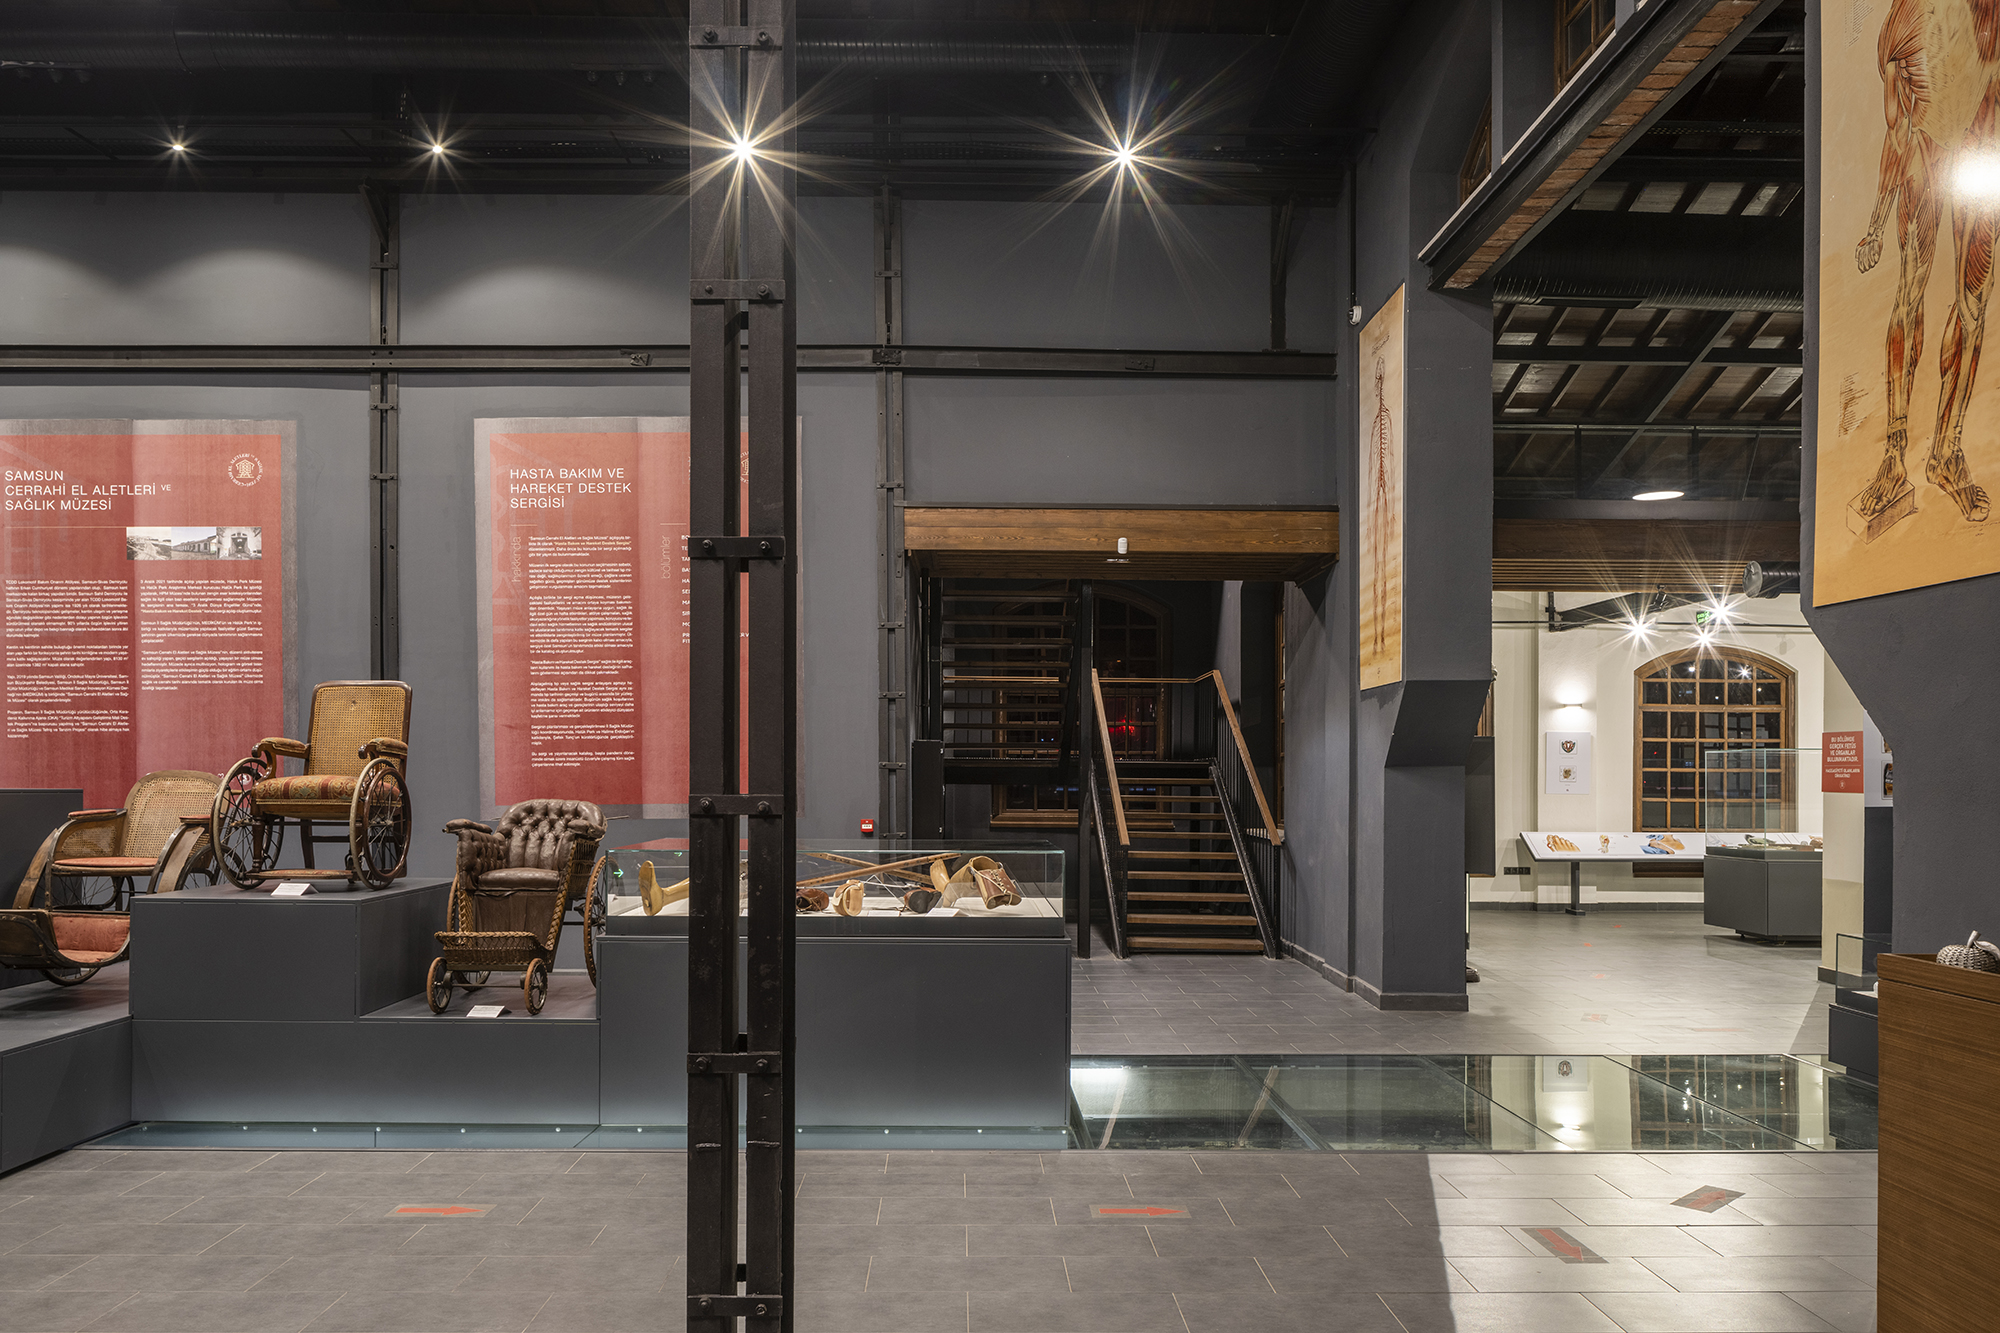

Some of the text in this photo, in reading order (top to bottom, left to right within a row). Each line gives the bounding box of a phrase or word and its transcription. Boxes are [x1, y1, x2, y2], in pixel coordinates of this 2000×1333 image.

[5, 470, 64, 481] SAMSUN
[510, 468, 624, 479] HASTA BAKIM VE
[5, 483, 66, 495] CERRAHİ
[72, 486, 86, 495] EL
[92, 483, 156, 495] ALETLERİ
[510, 483, 631, 494] HAREKET DESTEK
[5, 498, 112, 510] SAĞLIK MÜZESİ
[510, 496, 564, 508] SERGİSİ
[660, 535, 671, 579] bölümler
